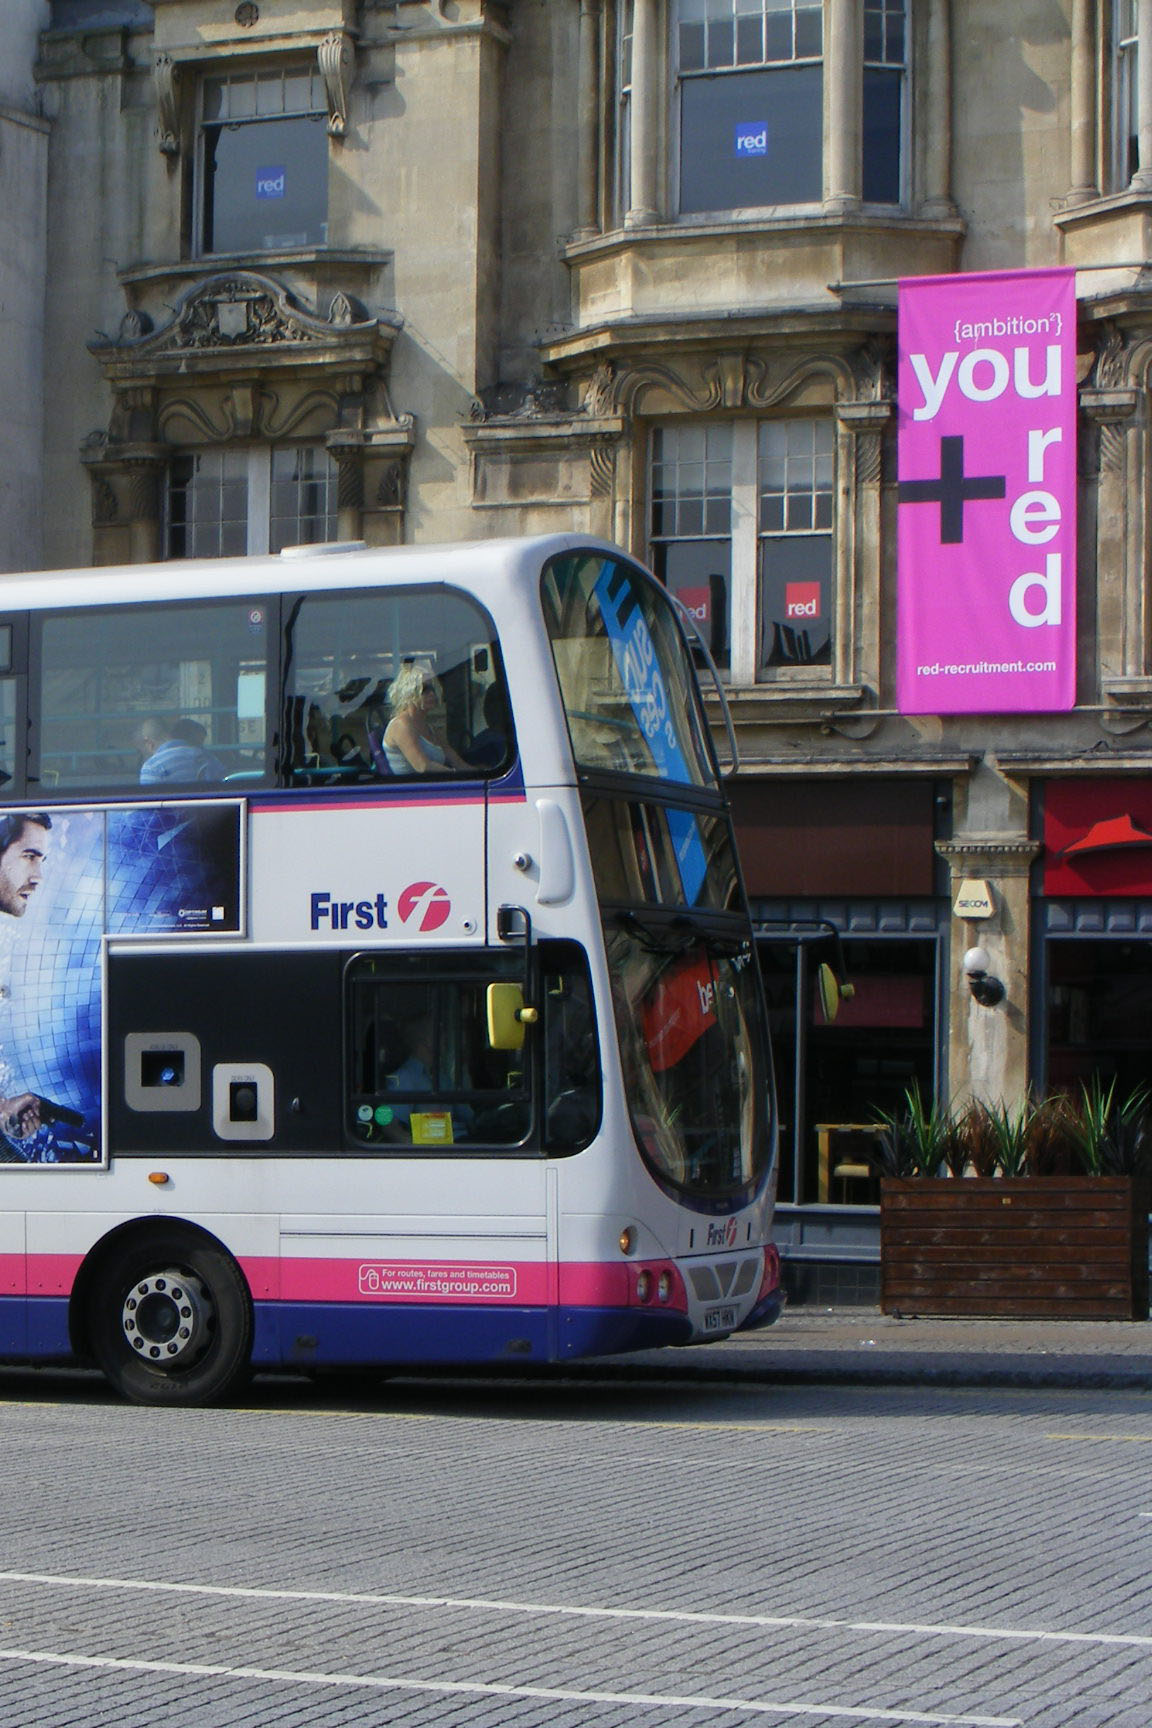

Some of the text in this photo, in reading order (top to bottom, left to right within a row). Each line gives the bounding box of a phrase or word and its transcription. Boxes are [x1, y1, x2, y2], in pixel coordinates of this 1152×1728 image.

[738, 131, 766, 150] red
[258, 175, 284, 192] red
[909, 345, 1062, 421] you
[1009, 427, 1062, 628] red
[788, 599, 816, 616] red
[917, 660, 1056, 676] red-recruitment.com
[311, 892, 388, 930] First
[707, 1222, 726, 1246] First
[382, 1269, 509, 1280] For routes, fares and timetables
[381, 1279, 511, 1294] www.firstgroup.com
